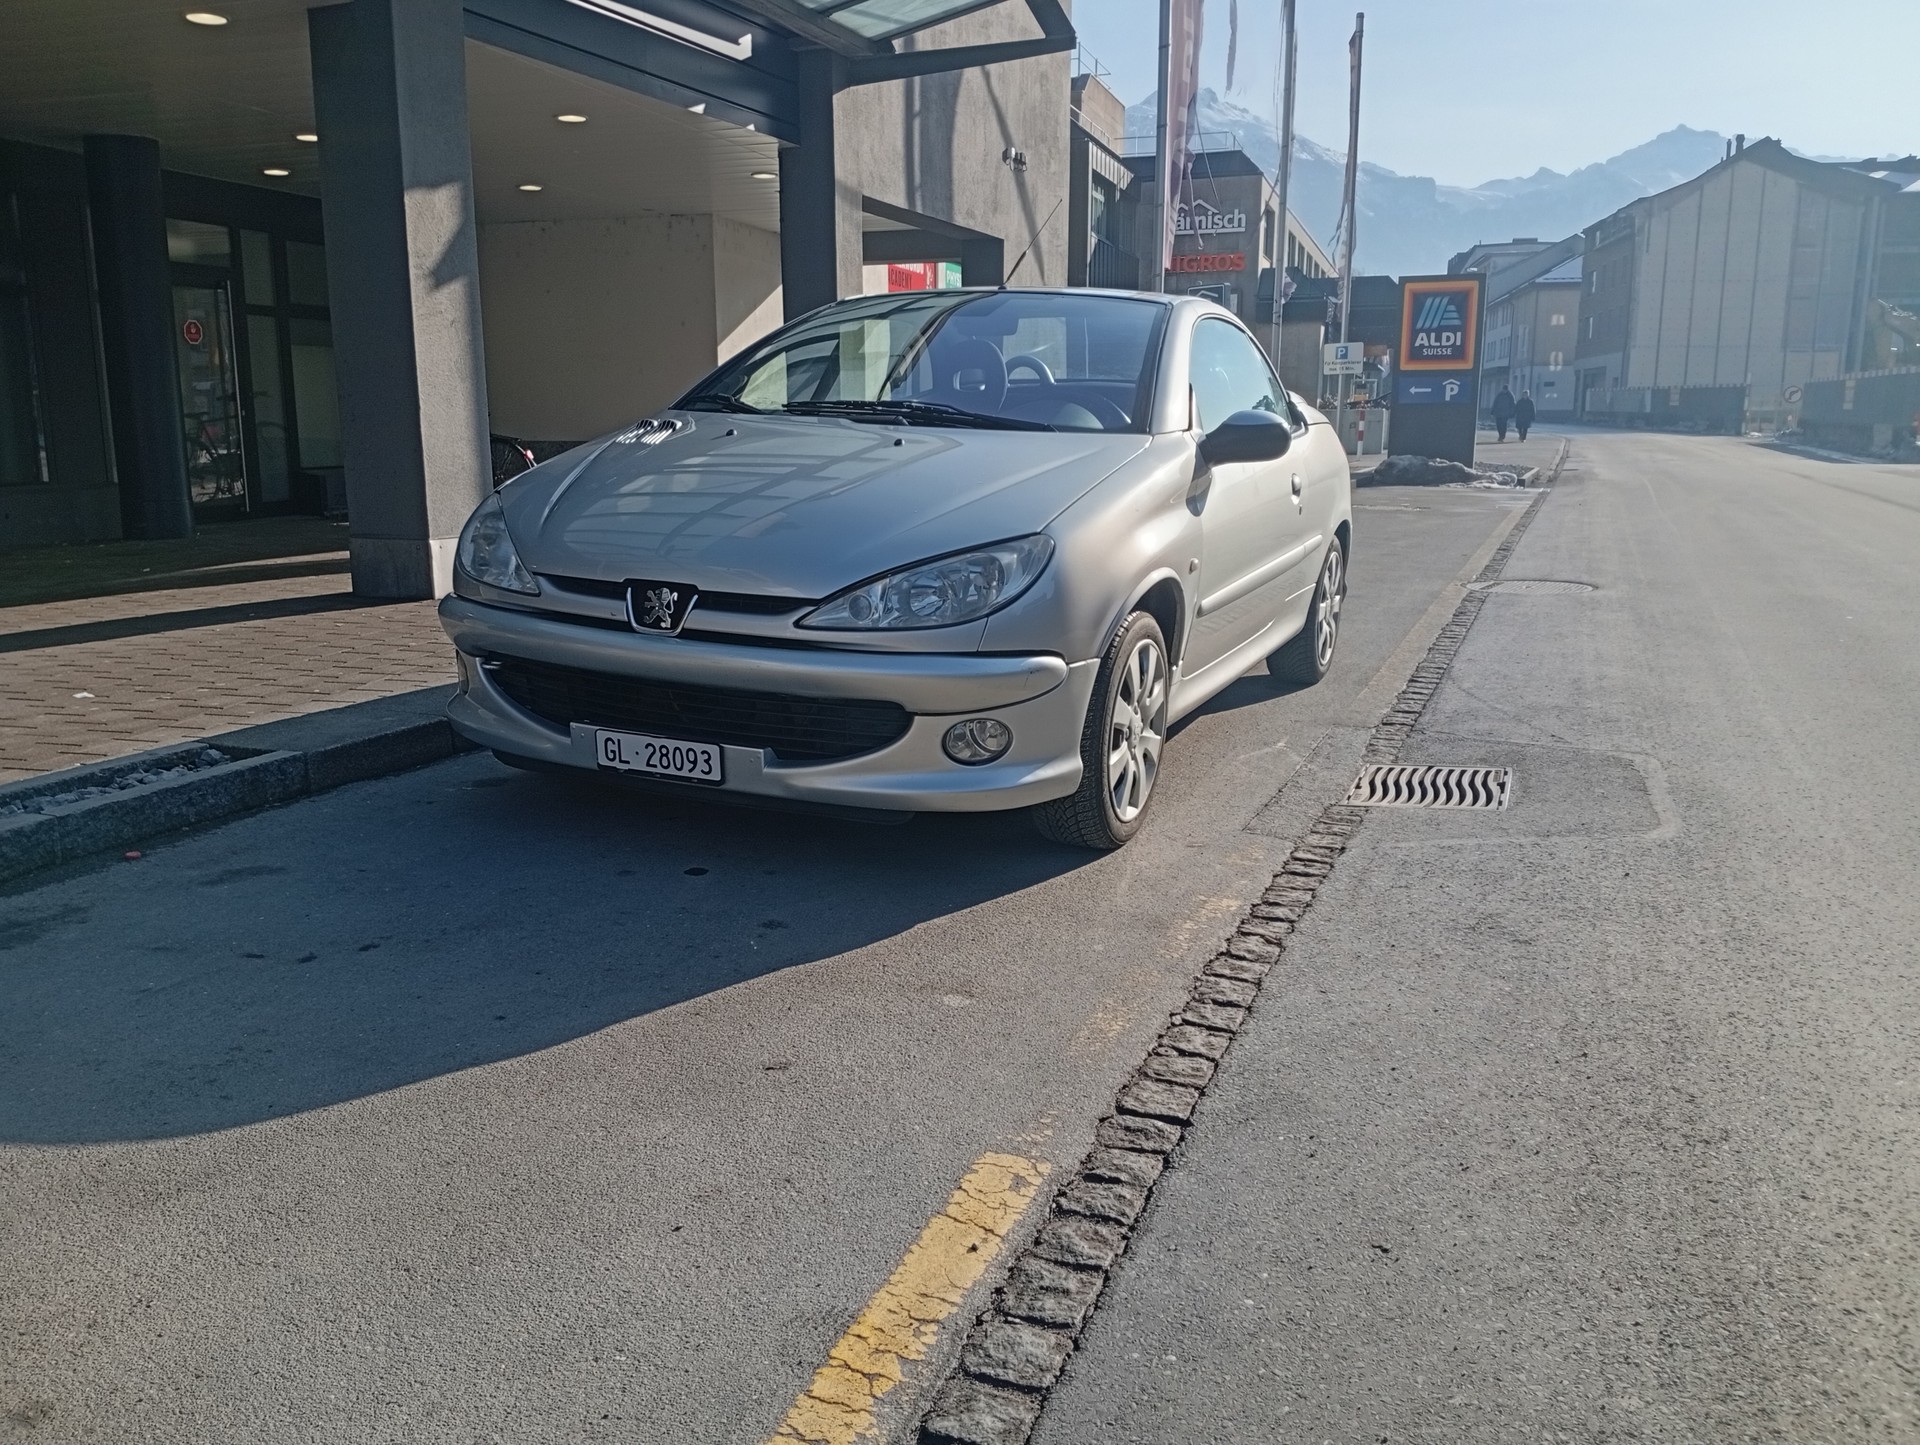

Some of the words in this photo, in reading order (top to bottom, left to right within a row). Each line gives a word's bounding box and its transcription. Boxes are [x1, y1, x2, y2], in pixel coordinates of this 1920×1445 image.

[1169, 253, 1246, 273] IGROS
[888, 268, 912, 290] CADEMY
[1414, 332, 1462, 347] ALDI
[604, 737, 631, 765] GL
[644, 743, 713, 776] 28093
